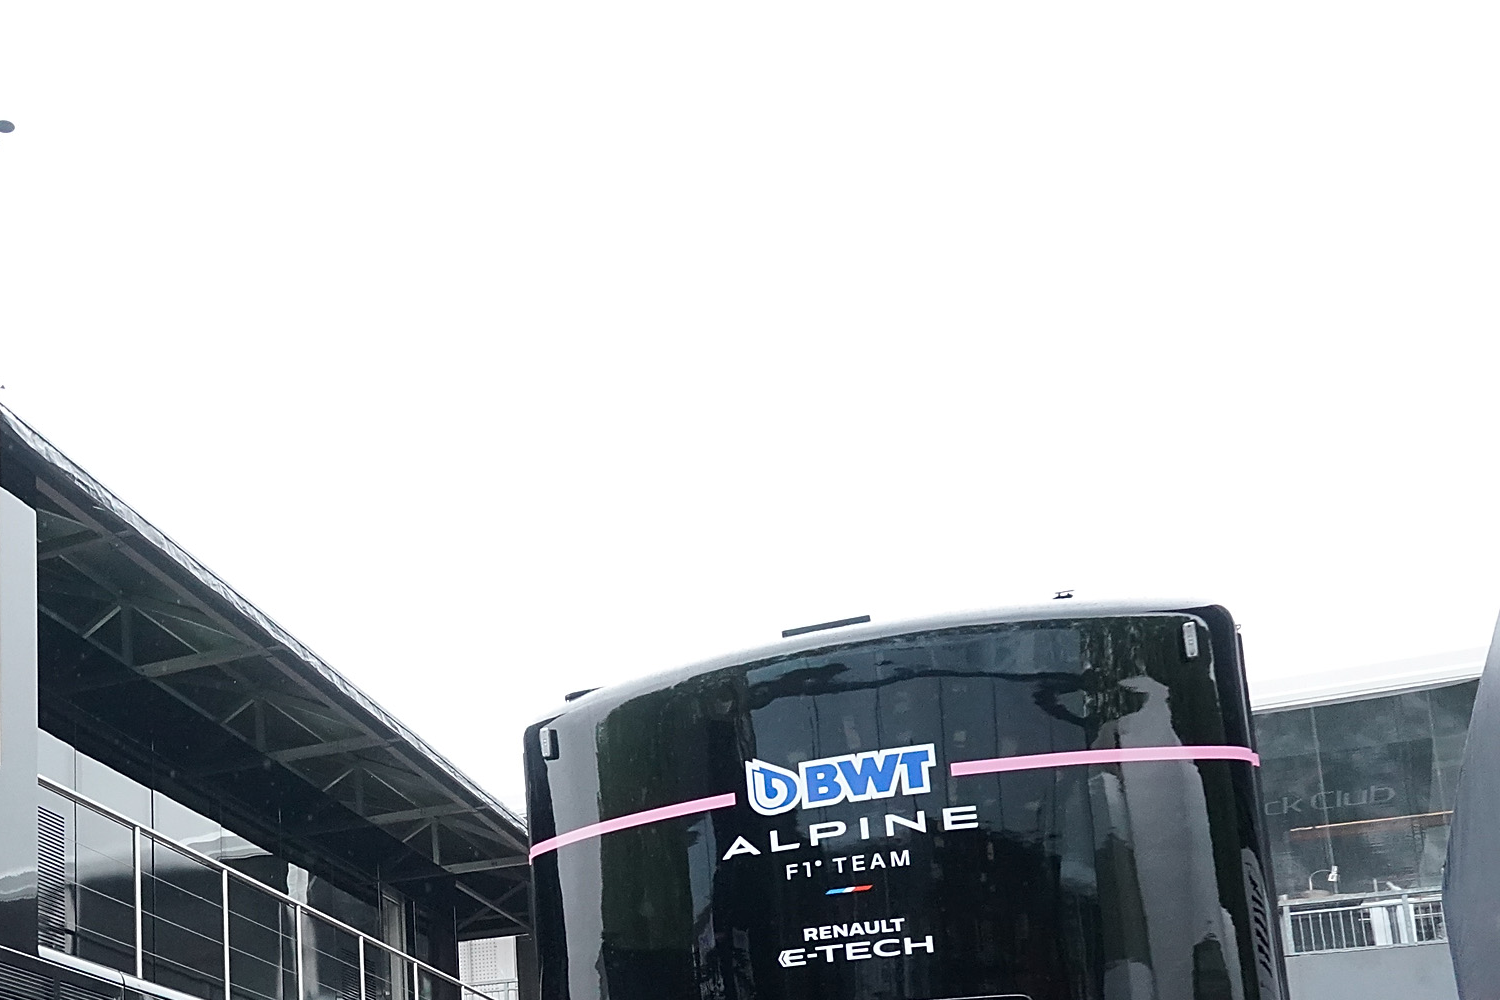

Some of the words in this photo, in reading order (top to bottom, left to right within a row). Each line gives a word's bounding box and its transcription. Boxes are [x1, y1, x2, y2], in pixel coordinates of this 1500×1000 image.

[798, 743, 936, 809] BWT
[722, 805, 979, 860] ALPINE
[832, 850, 911, 873] TEAM
[803, 917, 905, 941] RENAULT
[778, 935, 934, 967] E-TECH
